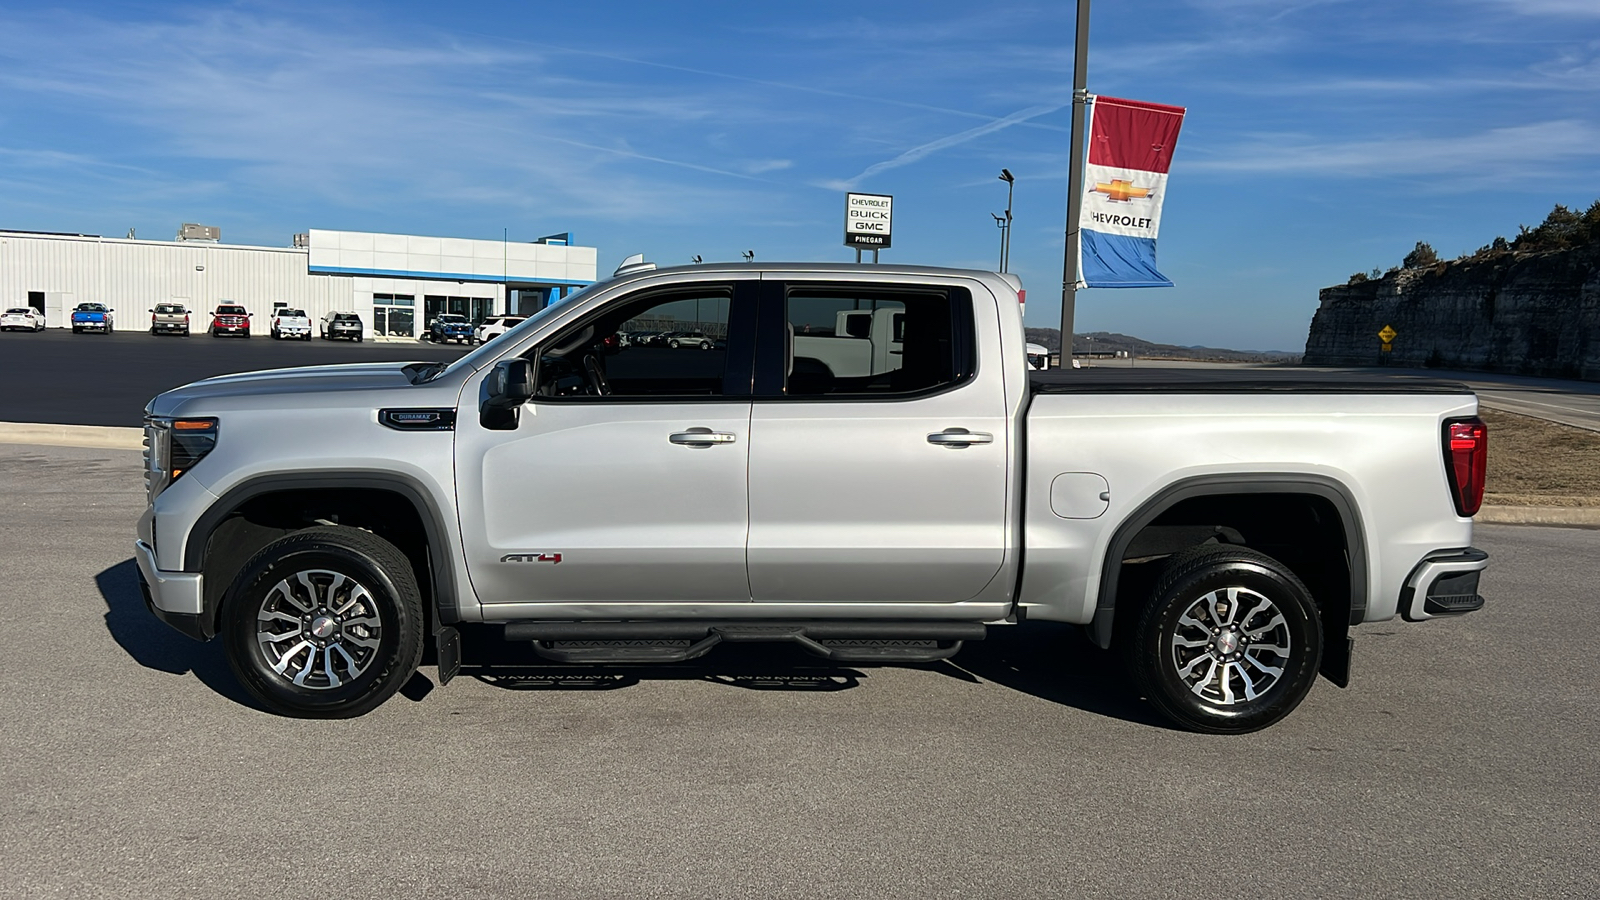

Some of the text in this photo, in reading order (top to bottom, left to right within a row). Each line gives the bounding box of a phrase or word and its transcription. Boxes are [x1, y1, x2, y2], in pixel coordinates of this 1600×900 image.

[851, 198, 889, 207] CHEVROLET
[850, 210, 889, 220] BUICK
[1090, 211, 1152, 229] HEVROLET
[855, 222, 884, 231] GMC
[855, 235, 883, 244] PINEGAR
[500, 553, 562, 565] AT4
